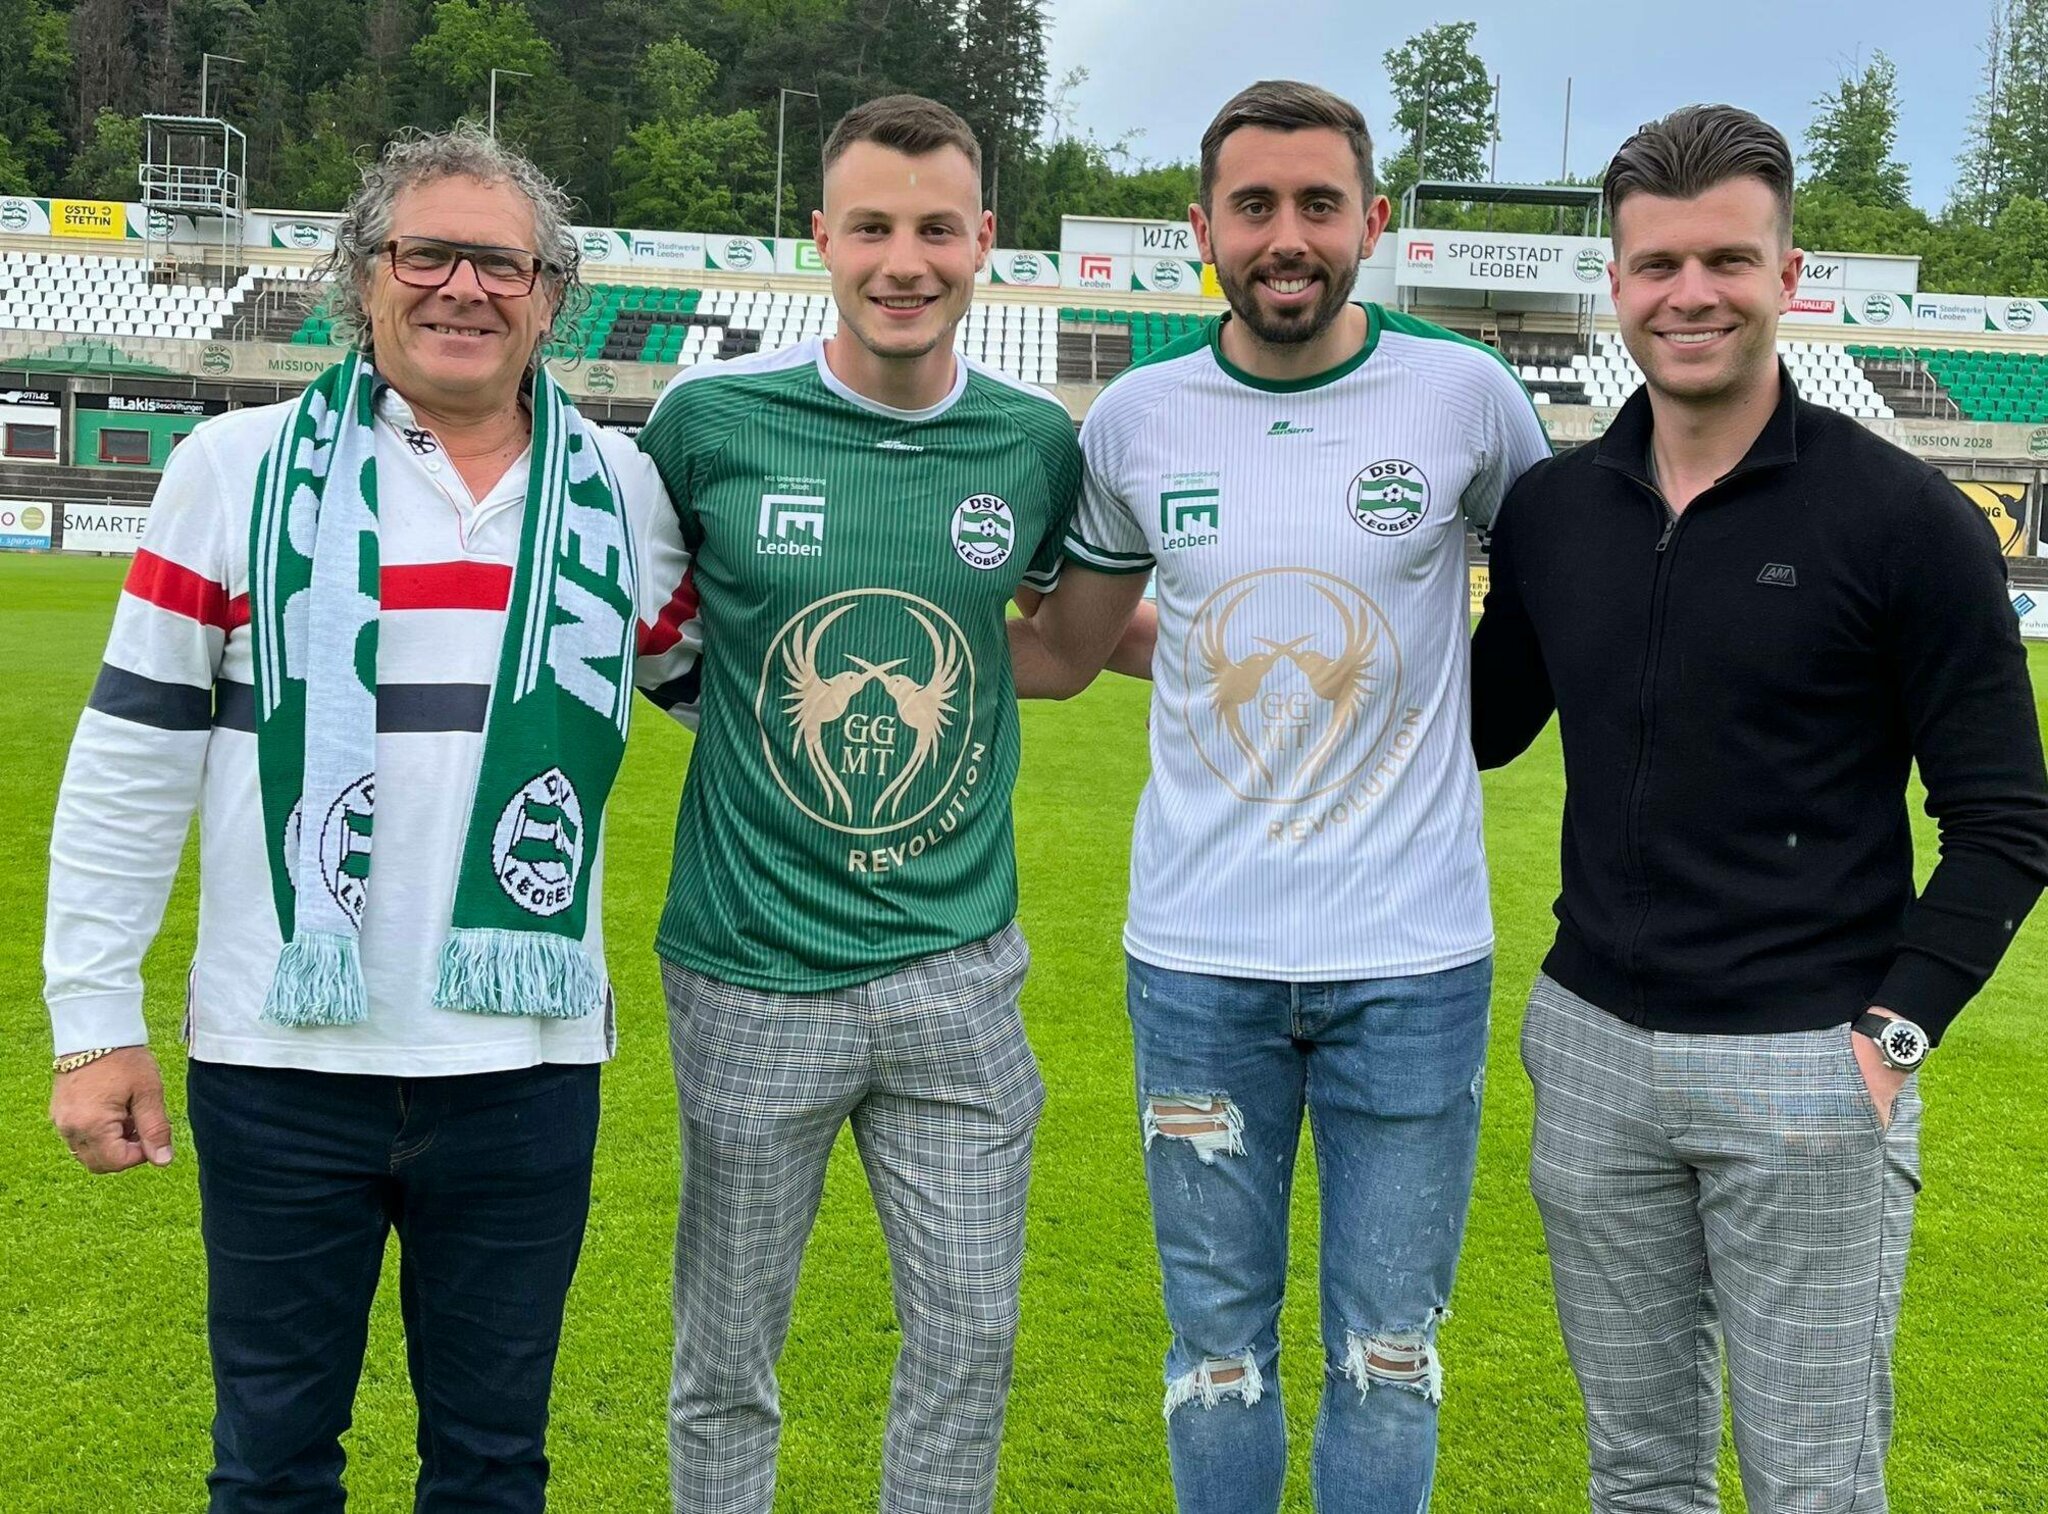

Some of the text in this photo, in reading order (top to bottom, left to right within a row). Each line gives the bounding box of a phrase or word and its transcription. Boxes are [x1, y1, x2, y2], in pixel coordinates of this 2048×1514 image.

[64, 214, 111, 226] STETTIN
[1142, 226, 1190, 250] WIR
[656, 250, 685, 258] Leoben
[1448, 243, 1563, 263] SPORTSTADT
[1469, 262, 1538, 280] LEOBEN
[1079, 279, 1111, 289] Leoben
[1938, 313, 1967, 321] Leoben
[268, 359, 324, 372] MISSION
[120, 397, 156, 412] Lakis
[1905, 435, 1993, 449] MISSION 2028
[1368, 462, 1414, 479] DSV
[969, 496, 1005, 513] DSV
[1357, 512, 1420, 532] LEOBEN
[757, 538, 822, 557] Leoben
[1162, 532, 1218, 550] Leoben
[957, 543, 1007, 567] LEOBEN
[1260, 691, 1311, 722] GG
[843, 713, 896, 745] GG
[1262, 722, 1312, 751] MT
[840, 745, 895, 776] MT
[1267, 706, 1425, 843] REVOLUTION
[848, 742, 986, 873] REVOLUTION
